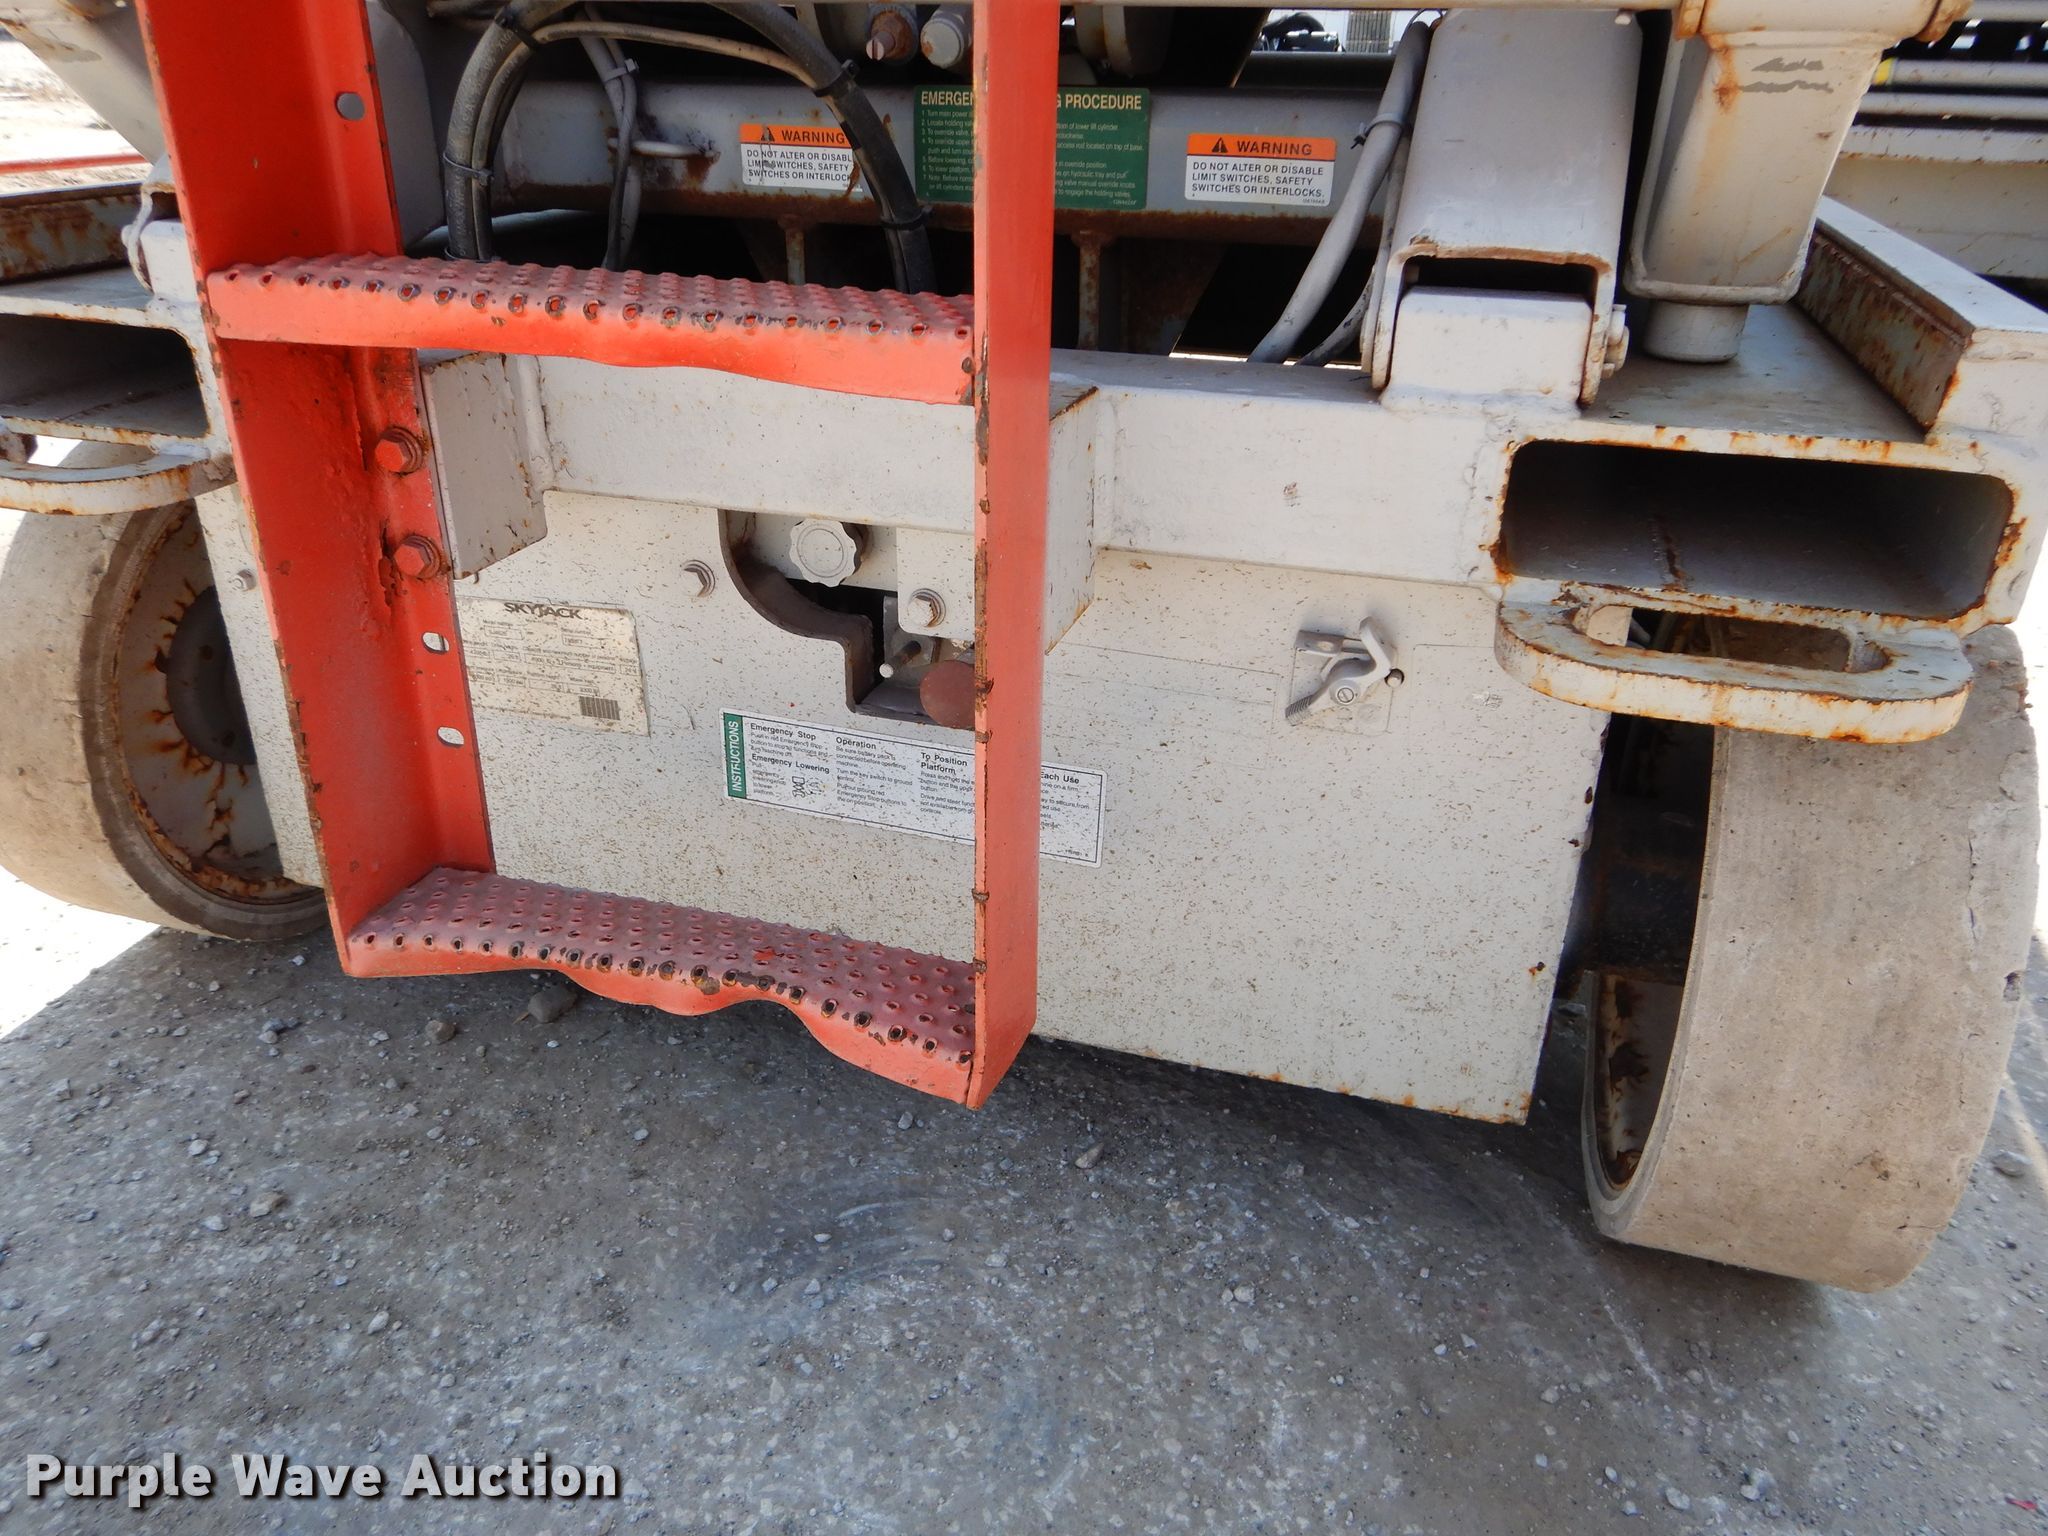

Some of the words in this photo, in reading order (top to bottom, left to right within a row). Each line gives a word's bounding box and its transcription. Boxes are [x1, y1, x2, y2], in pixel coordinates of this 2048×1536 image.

[1065, 94, 1142, 110] PROCEDURE
[782, 130, 845, 144] WARNING
[1237, 140, 1312, 155] WARNING
[822, 154, 852, 162] DISABL
[749, 170, 790, 178] SWITCHES
[818, 163, 849, 171] SAFETY
[1193, 162, 1206, 170] DO
[1210, 162, 1228, 171] NOT
[1232, 164, 1262, 172] ALTER
[1264, 164, 1278, 173] OR
[1281, 165, 1323, 176] DISABLE
[1220, 174, 1272, 185] SWITCHES,
[1275, 176, 1313, 186] SAFETY
[1192, 183, 1241, 193] SWITCHES
[1243, 186, 1257, 194] OR
[1260, 186, 1324, 197] INTERLOCKS.
[504, 602, 583, 620] SKYJACK
[750, 723, 793, 737] Emergency
[798, 731, 816, 741] Stop
[836, 737, 876, 749] Operation
[728, 721, 742, 792] INSTRUCTIONS
[752, 753, 792, 767] Emergency
[796, 761, 830, 774] Lowering
[921, 752, 931, 761] To
[934, 754, 968, 766] Position
[921, 762, 956, 775] Platform
[1063, 775, 1079, 784] Use
